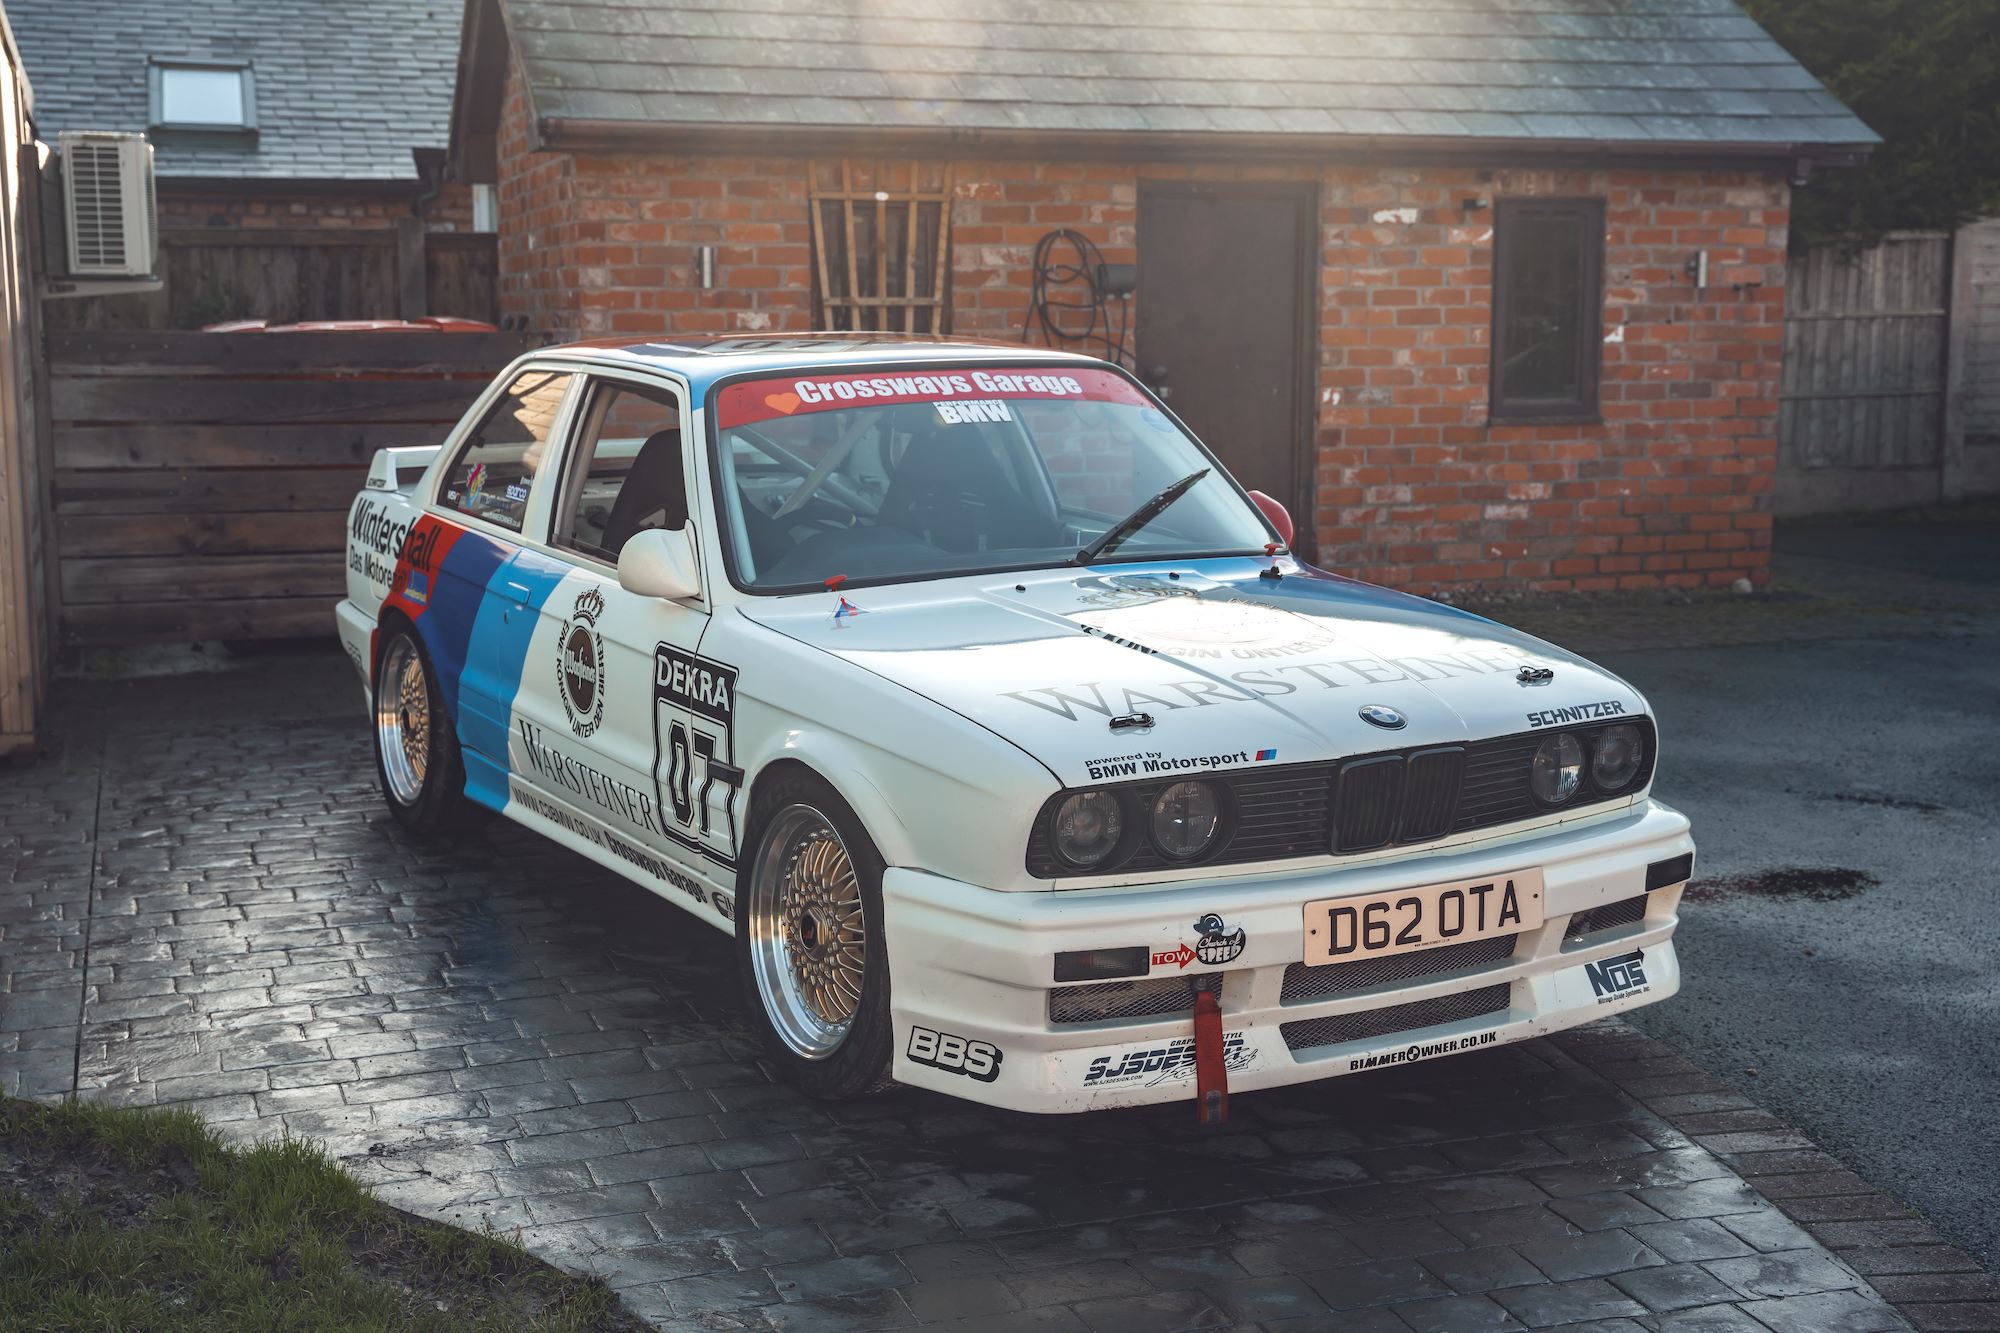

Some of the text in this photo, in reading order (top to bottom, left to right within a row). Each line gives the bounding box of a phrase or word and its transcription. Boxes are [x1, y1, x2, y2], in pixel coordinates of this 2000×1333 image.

[794, 371, 1083, 403] Crossways Garage
[932, 399, 1005, 407] PERFORMANCE
[936, 404, 1013, 425] BMW
[506, 484, 527, 500] sparco
[353, 497, 442, 572] Wintershall
[350, 544, 362, 574] Das
[557, 618, 570, 655] EINE
[556, 657, 574, 725] KÖNIGIN
[657, 654, 730, 712] DEKRA
[997, 649, 1560, 722] WARSTEINER
[572, 720, 595, 739] UNTER
[593, 698, 604, 731] DEN
[1527, 700, 1626, 728] SCHNITZER
[1084, 751, 1162, 767] powered by
[1088, 750, 1249, 780] BMW Motorsport
[518, 718, 661, 836] WARSTEINER
[668, 719, 717, 838] 07
[604, 830, 666, 881] Crossways
[661, 861, 708, 903] Garage
[1328, 880, 1521, 955] D62 OTA
[1198, 931, 1241, 948] Church of
[1198, 945, 1242, 962] SPEED
[1154, 951, 1191, 964] TOW
[1584, 947, 1648, 996] NOS
[907, 1025, 1003, 1083] BBS
